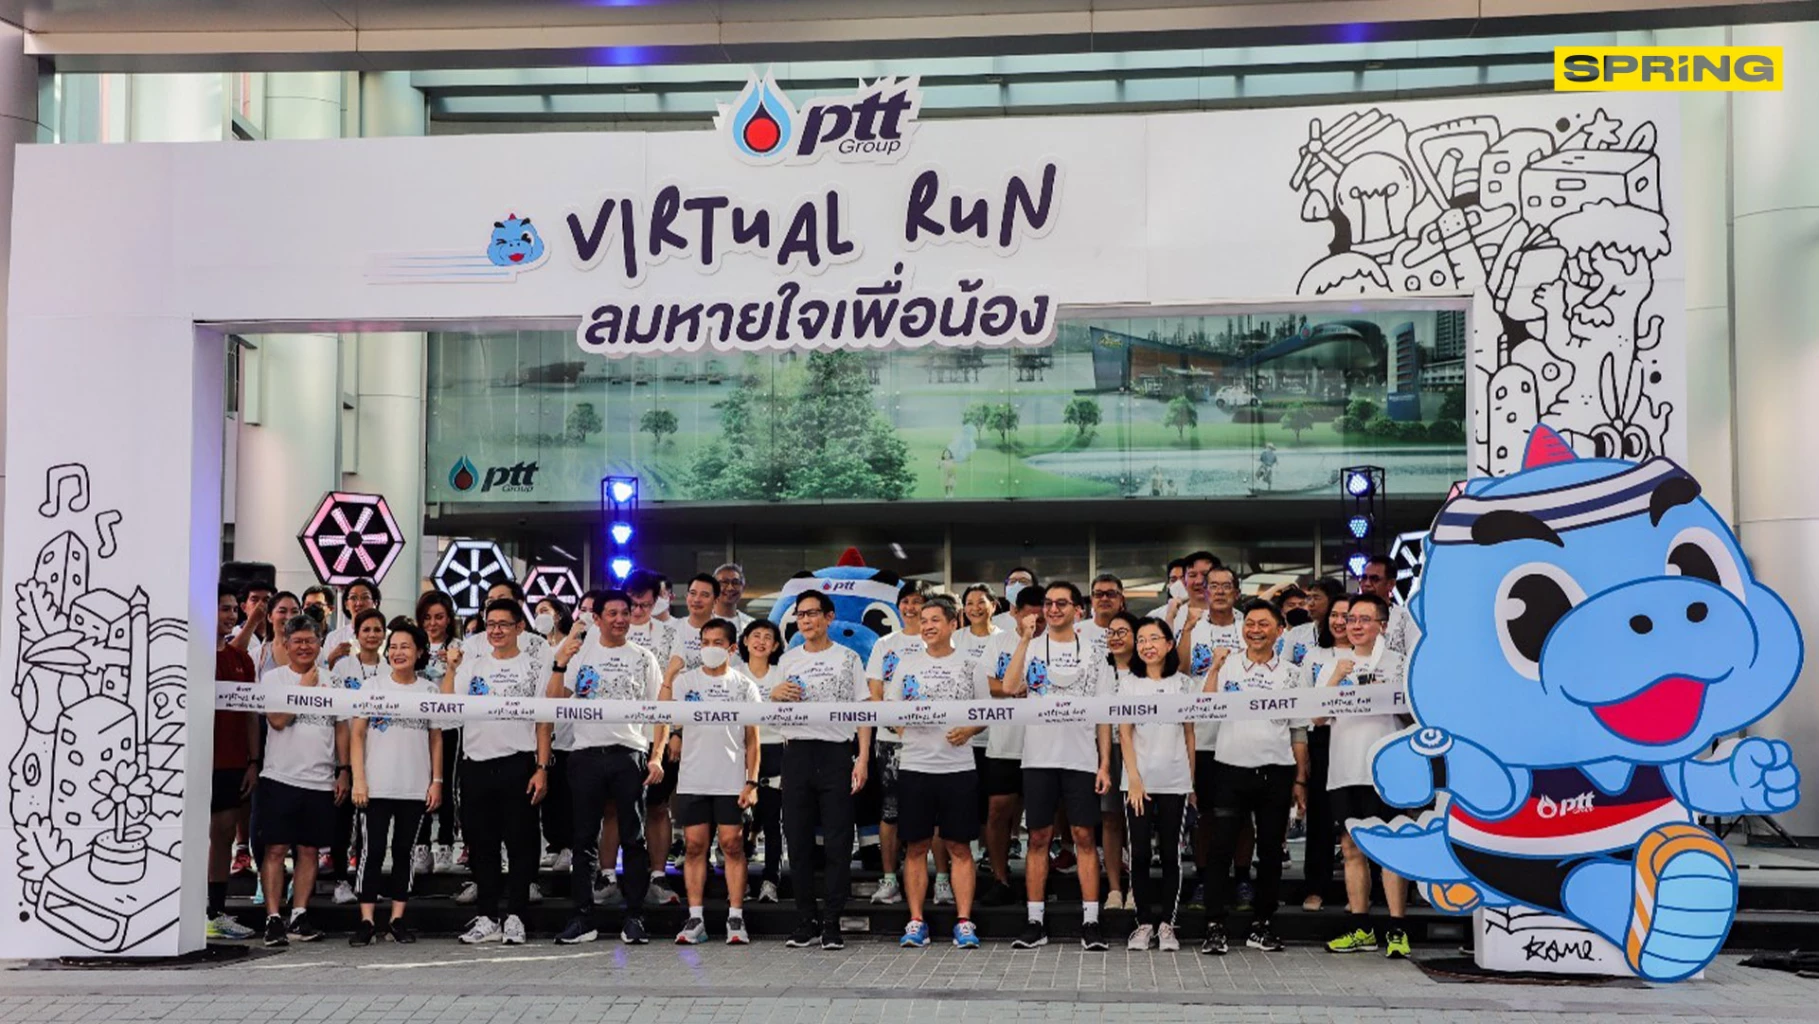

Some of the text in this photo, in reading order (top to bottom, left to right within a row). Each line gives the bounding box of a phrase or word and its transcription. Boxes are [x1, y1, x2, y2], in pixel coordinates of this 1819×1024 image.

[797, 90, 912, 156] ptt
[838, 136, 902, 155] Group
[586, 262, 1049, 344] ลมหายใจเพื่อน้อง
[481, 461, 539, 492] ptt
[833, 581, 856, 591] ptt
[286, 694, 333, 708] FINISH
[419, 701, 465, 714] START
[1249, 697, 1298, 711] START
[556, 706, 604, 721] FINISH
[693, 711, 739, 722] START
[829, 711, 877, 722] FINISH
[967, 707, 1015, 721] START
[1108, 704, 1158, 716] FINISH
[1559, 791, 1596, 817] ptt
